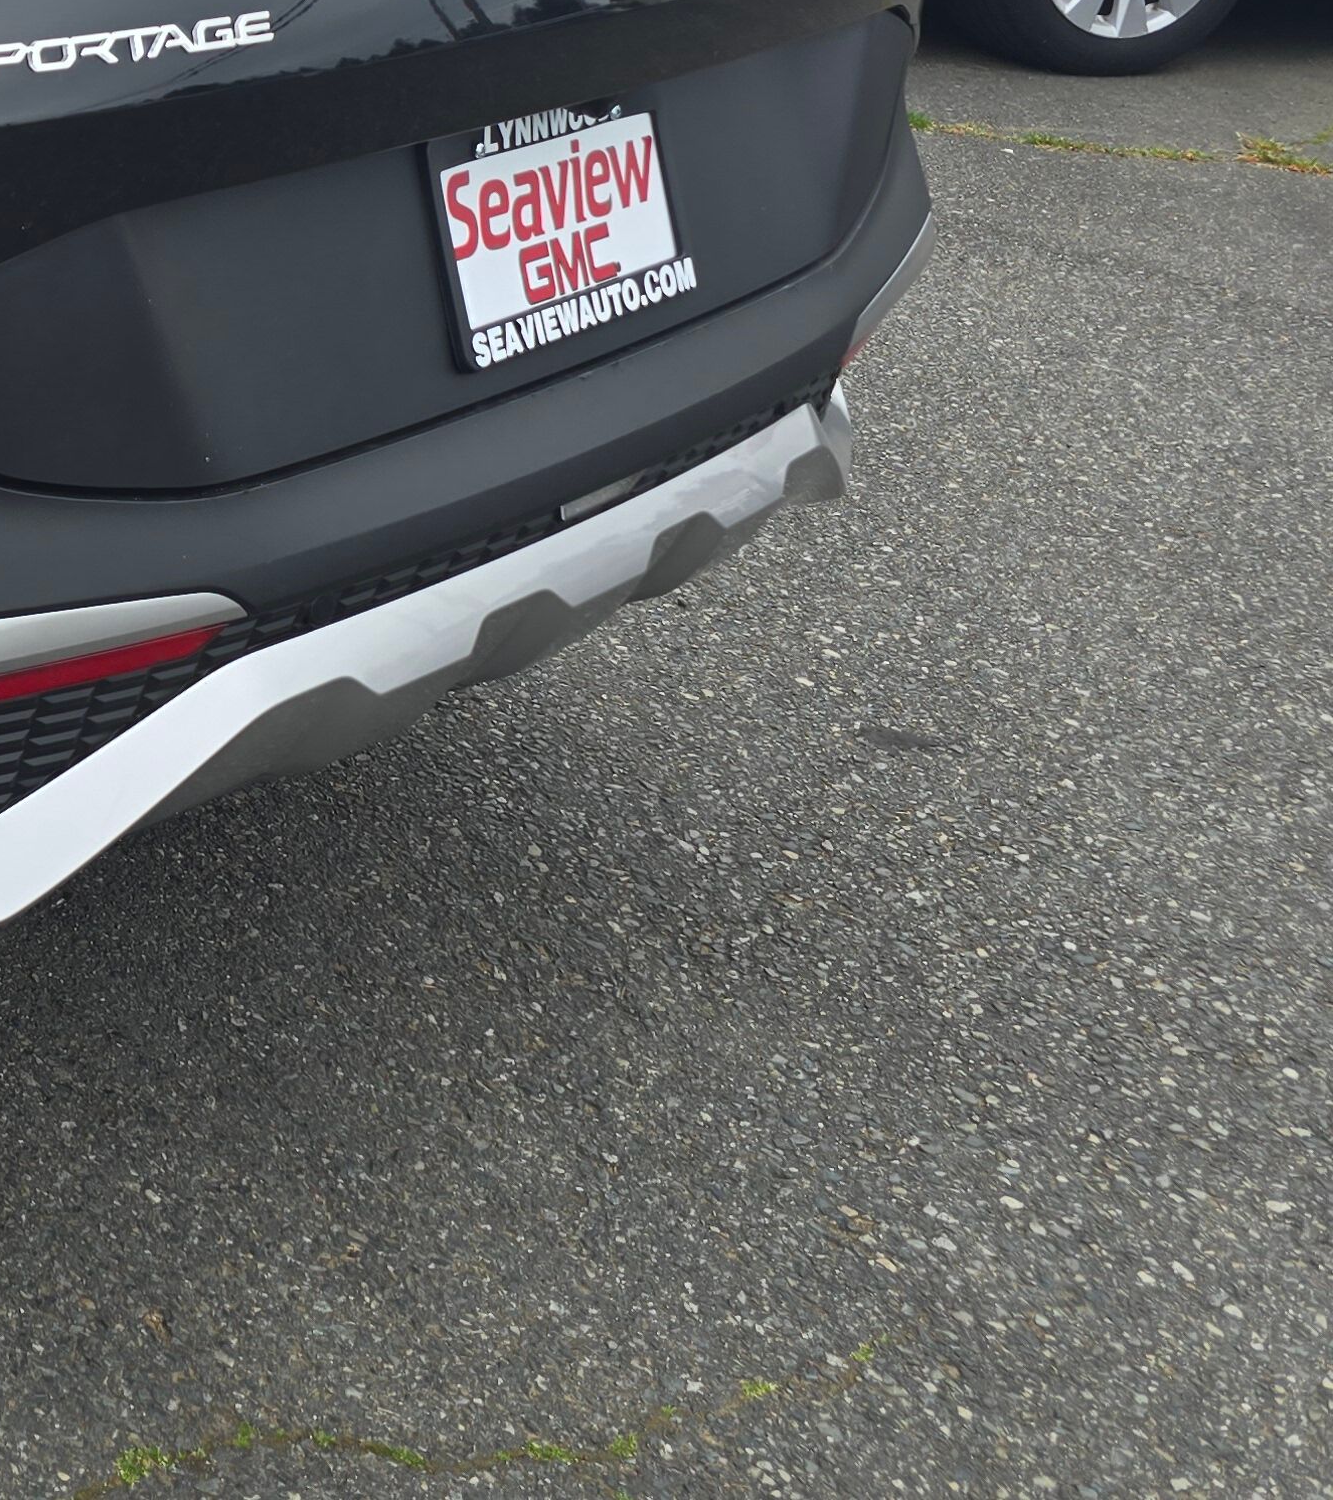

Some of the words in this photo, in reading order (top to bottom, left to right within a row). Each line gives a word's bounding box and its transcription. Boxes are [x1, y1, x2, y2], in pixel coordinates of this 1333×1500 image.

[484, 108, 610, 154] LYNNWO
[446, 135, 653, 261] Seaview
[519, 221, 620, 305] GMC
[472, 257, 697, 369] SEAVIEWAUTO.COM
